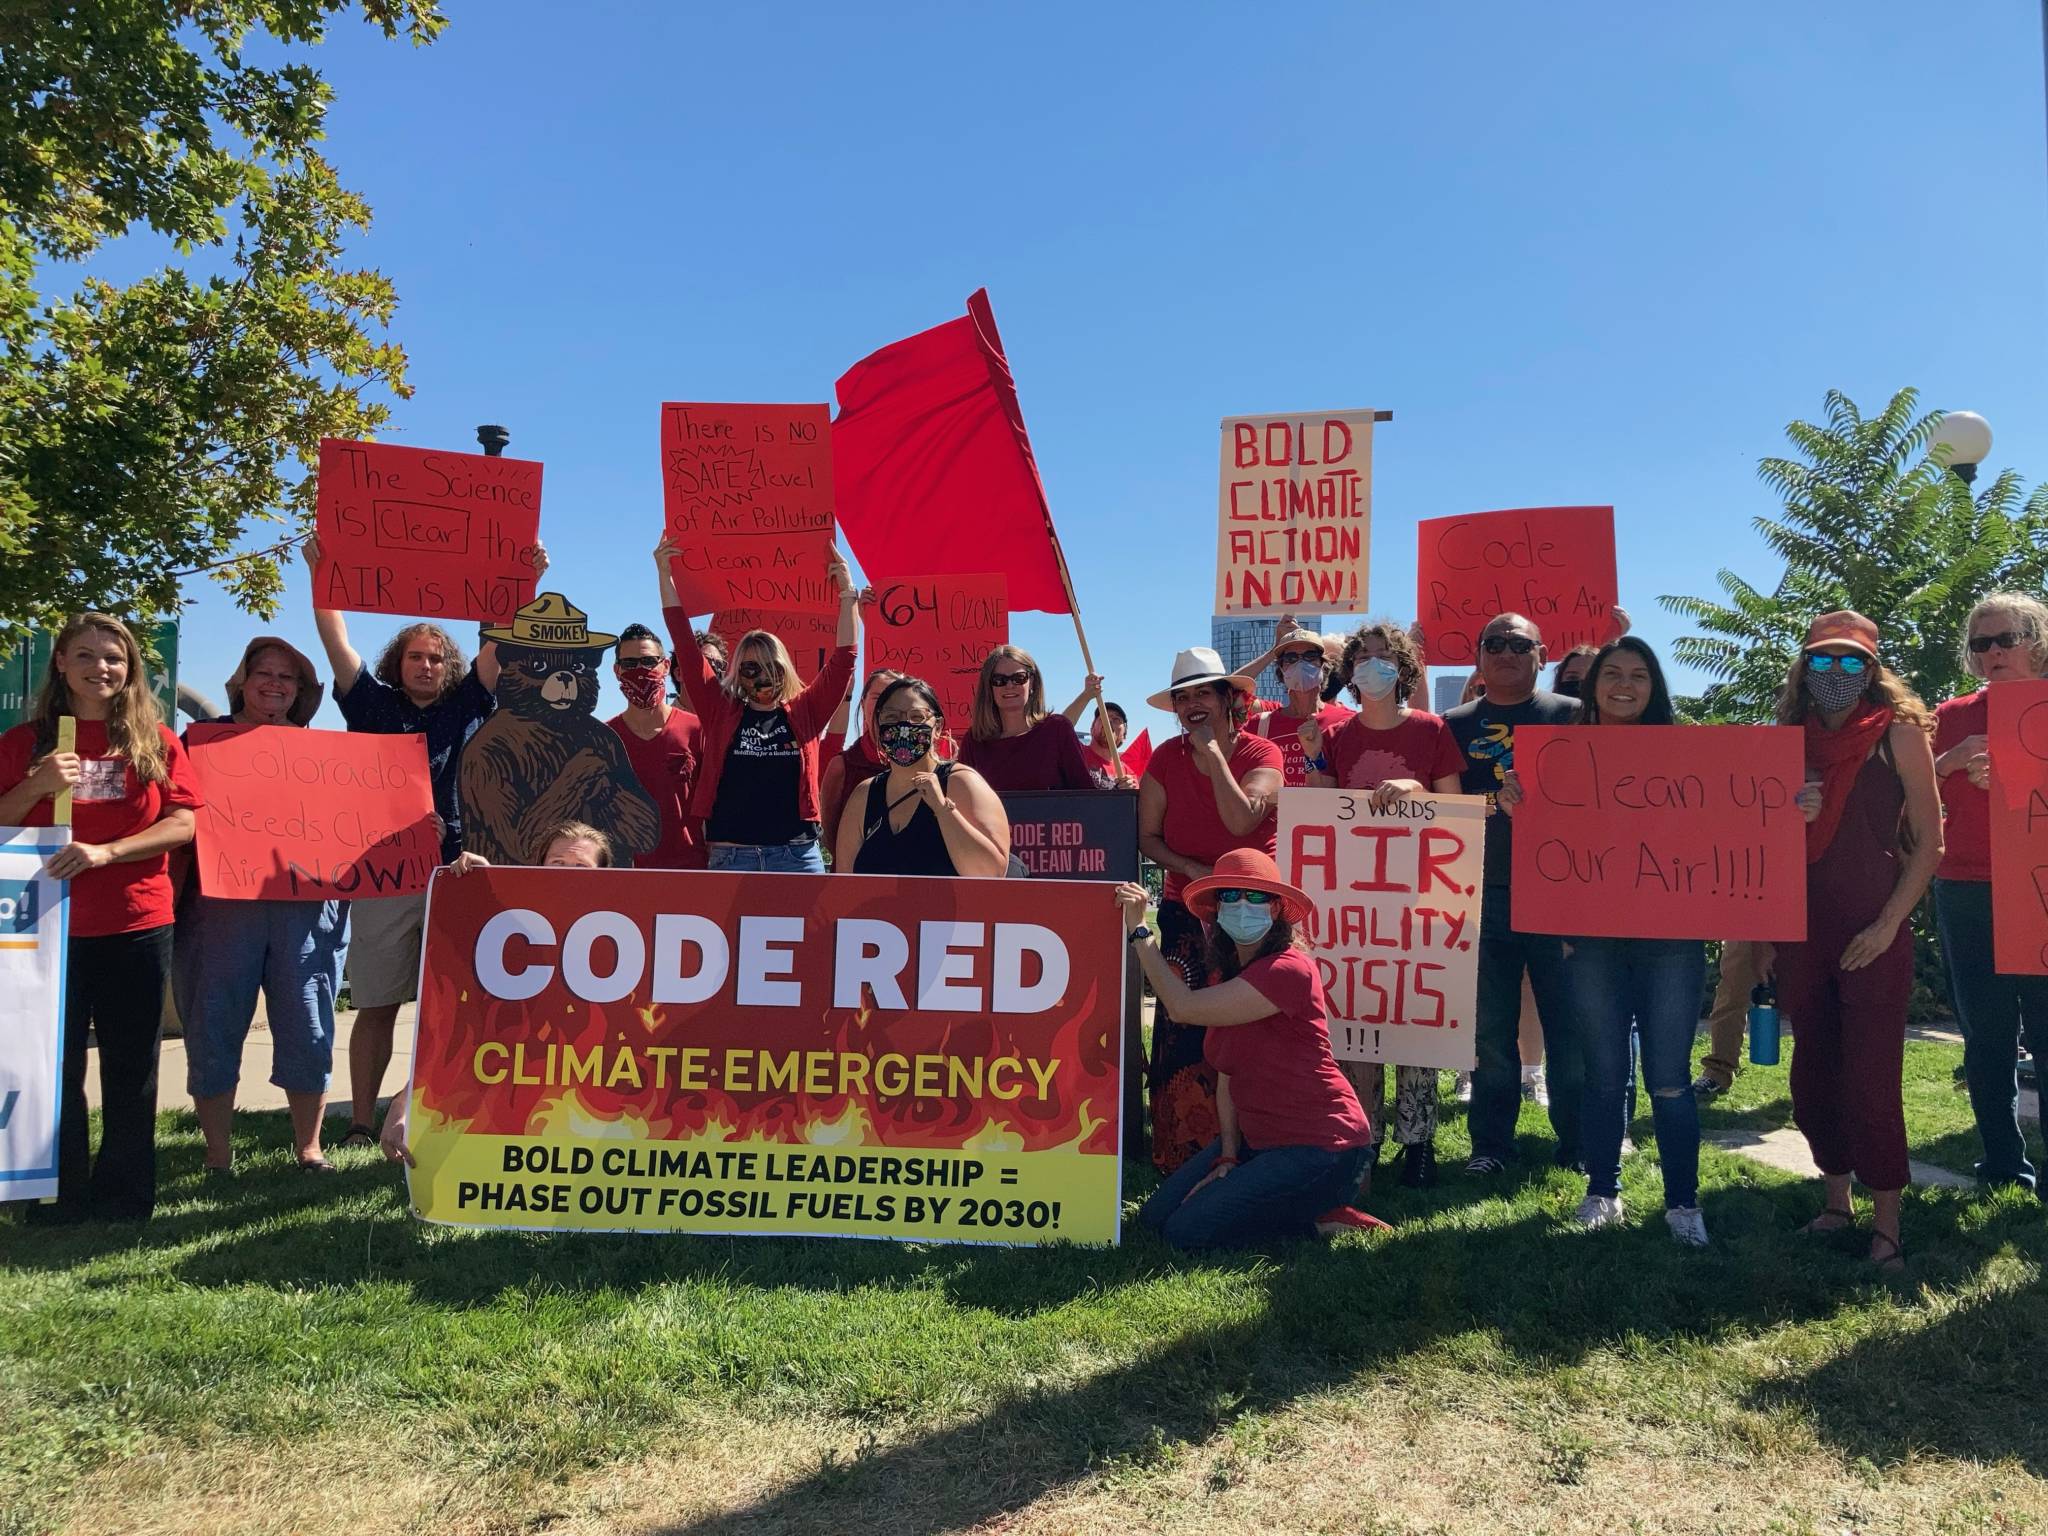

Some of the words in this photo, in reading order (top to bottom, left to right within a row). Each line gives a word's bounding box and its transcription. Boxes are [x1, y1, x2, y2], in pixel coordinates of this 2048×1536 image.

[668, 408, 736, 442] There
[755, 424, 774, 442] is
[789, 422, 816, 441] NO
[1235, 420, 1352, 469] BOLD
[340, 448, 407, 490] The
[423, 457, 537, 510] Science
[676, 458, 743, 494] SAFE
[759, 460, 814, 488] level
[1229, 469, 1363, 521] CLIMATE
[335, 500, 367, 537] is
[381, 509, 460, 543] Clear
[480, 518, 534, 567] the
[674, 505, 700, 531] of
[712, 510, 744, 529] Air
[753, 507, 834, 528] Pollution
[682, 547, 761, 572] Clean
[773, 547, 806, 572] Air
[1229, 526, 1360, 565] ACTION
[1438, 522, 1566, 570] Code
[329, 561, 395, 608] AIR
[415, 577, 444, 612] is
[464, 576, 530, 616] NOT
[880, 584, 940, 632] 64
[951, 591, 1007, 631] OZONE
[1431, 580, 1504, 621] Red
[1524, 580, 1562, 616] for
[1573, 586, 1606, 619] Air
[530, 624, 587, 640] SMOKEY
[871, 637, 924, 673] Days
[206, 730, 407, 788] Colorado
[1536, 738, 1703, 808] Clean
[1731, 774, 1786, 827] up
[204, 795, 323, 841] Needs
[334, 811, 417, 849] Clean
[1337, 796, 1355, 820] 3
[1368, 798, 1437, 820] WORDS
[1052, 823, 1083, 846] RED
[217, 851, 263, 887] Air
[1020, 849, 1072, 873] CLEAN
[1079, 848, 1105, 871] AIR
[1291, 825, 1475, 897] AIR.
[1536, 838, 1616, 882] Our
[1636, 842, 1764, 900] Air!!!!
[475, 908, 804, 1007] CODE
[834, 918, 1070, 1014] RED
[1316, 957, 1458, 1028] RISIS.
[1345, 1027, 1380, 1054] !!!
[473, 1042, 710, 1090] CLIMATE
[724, 1049, 1061, 1101] EMERGENCY
[503, 1145, 594, 1175] BOLD
[602, 1148, 757, 1181] CLIMATE
[766, 1153, 984, 1188] LEADERSHIP
[458, 1181, 571, 1212] PHASE
[579, 1185, 652, 1215] OUT
[658, 1188, 777, 1219] FOSSIL
[786, 1192, 897, 1223] FUELS
[903, 1196, 952, 1225] BY
[958, 1198, 1061, 1230] 2030!
